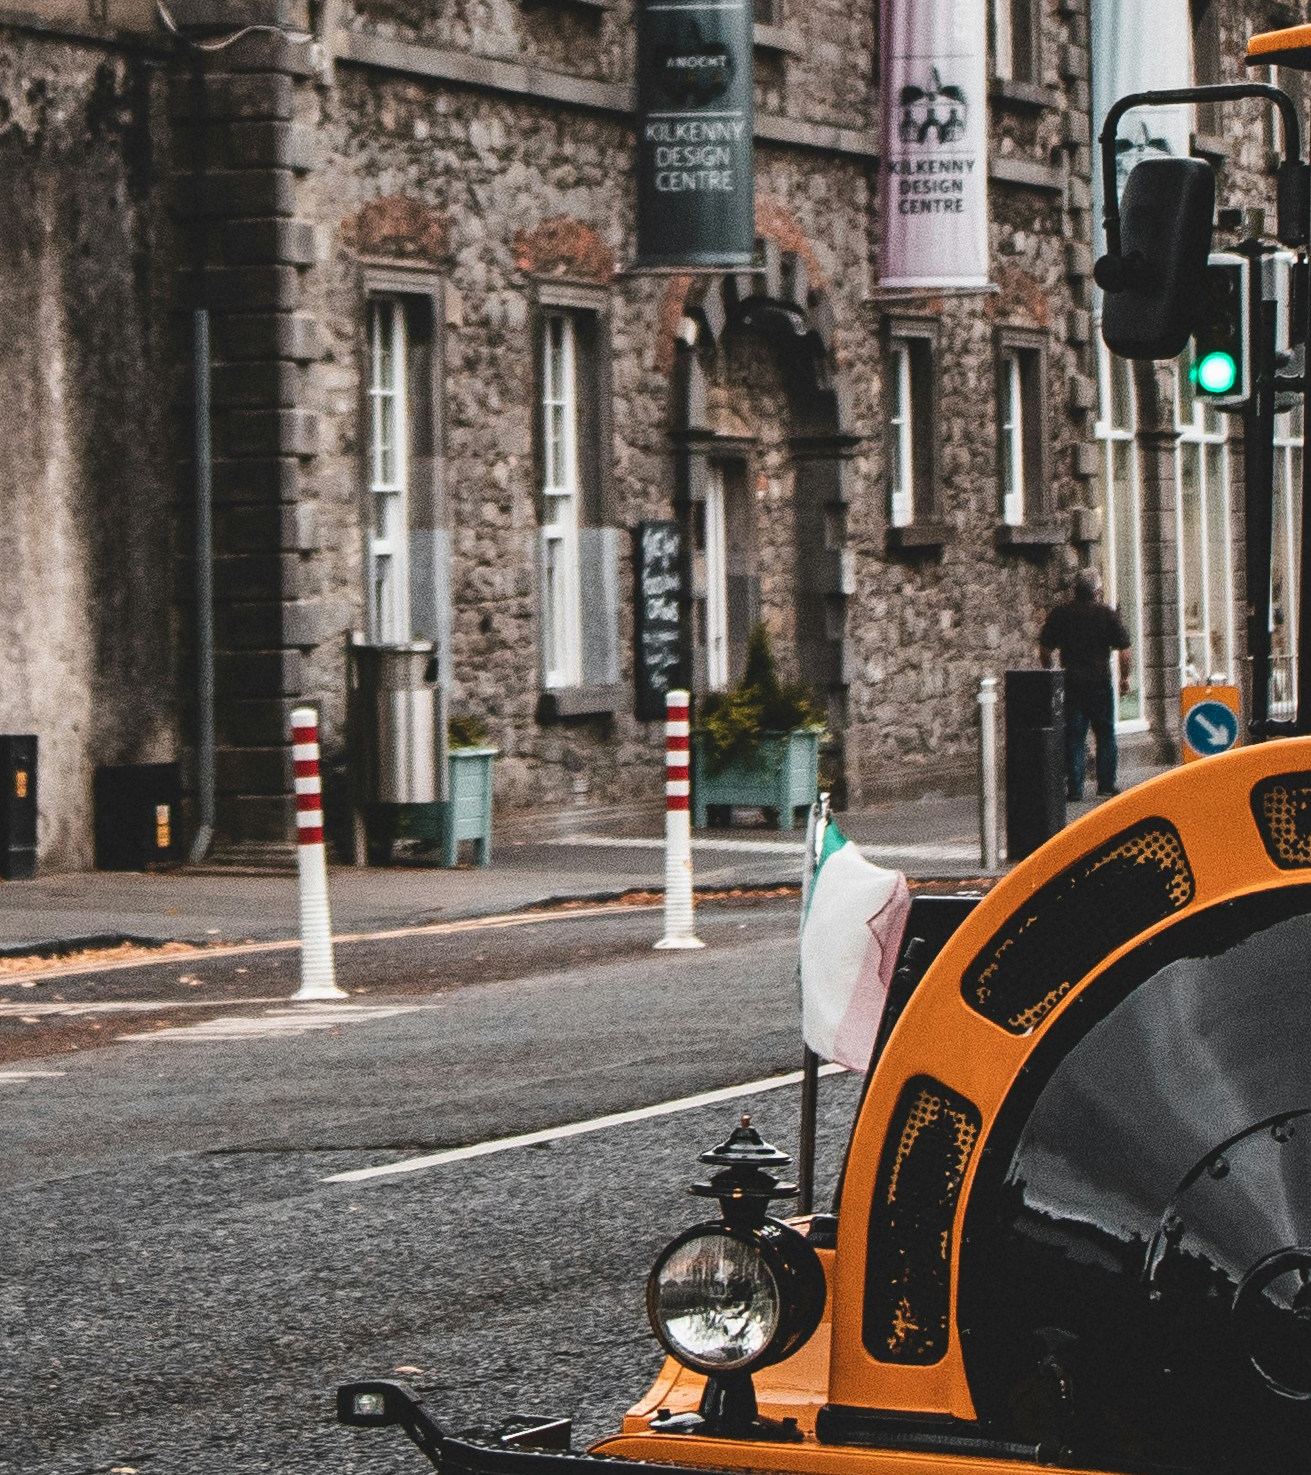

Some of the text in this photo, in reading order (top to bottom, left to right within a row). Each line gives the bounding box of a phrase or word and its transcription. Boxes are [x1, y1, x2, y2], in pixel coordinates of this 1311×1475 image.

[644, 121, 745, 142] KILKENNY
[655, 146, 731, 167] DESIGN
[889, 158, 975, 177] KILKENNY
[655, 169, 734, 192] CENTRE
[898, 179, 964, 197] DESIGN
[898, 198, 964, 215] CENTRE
